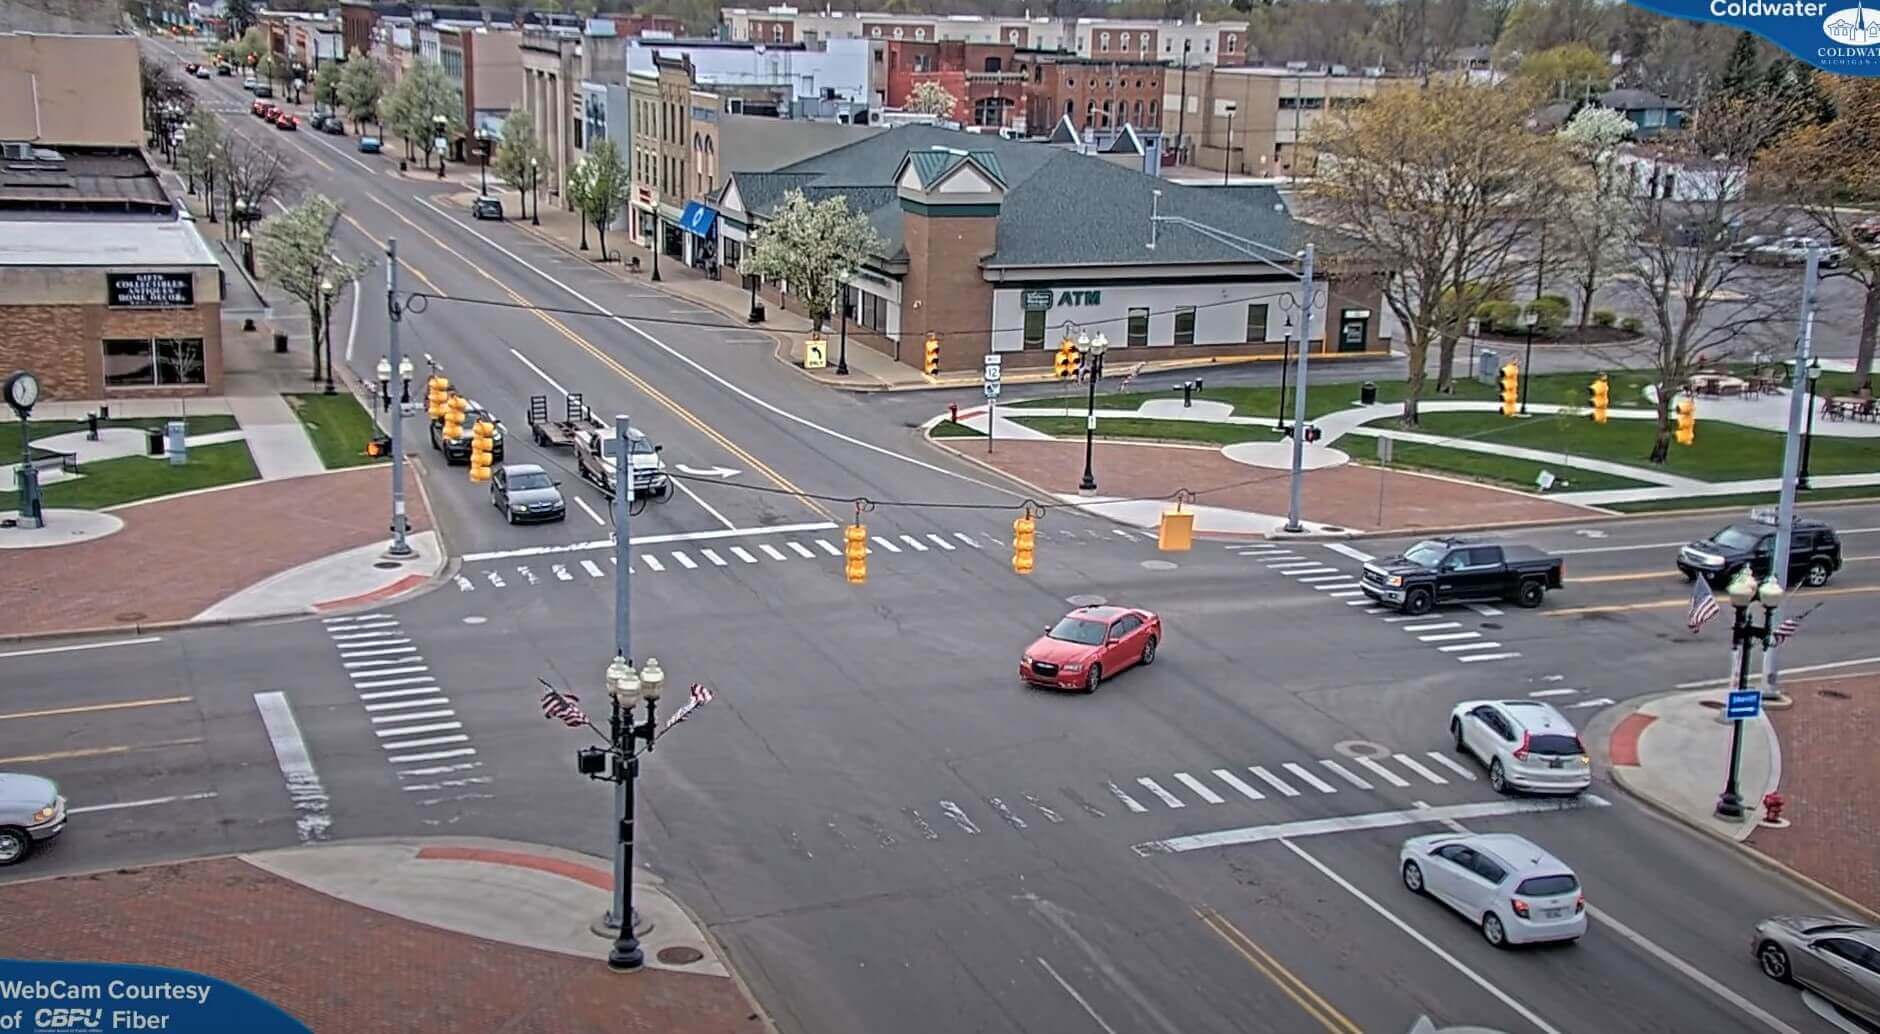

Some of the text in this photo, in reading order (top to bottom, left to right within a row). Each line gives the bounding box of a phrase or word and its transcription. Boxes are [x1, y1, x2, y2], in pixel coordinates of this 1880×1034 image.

[128, 288, 175, 296] ANTIQUES
[118, 294, 146, 302] HOME
[1057, 291, 1101, 306] ATM
[987, 367, 998, 378] 12
